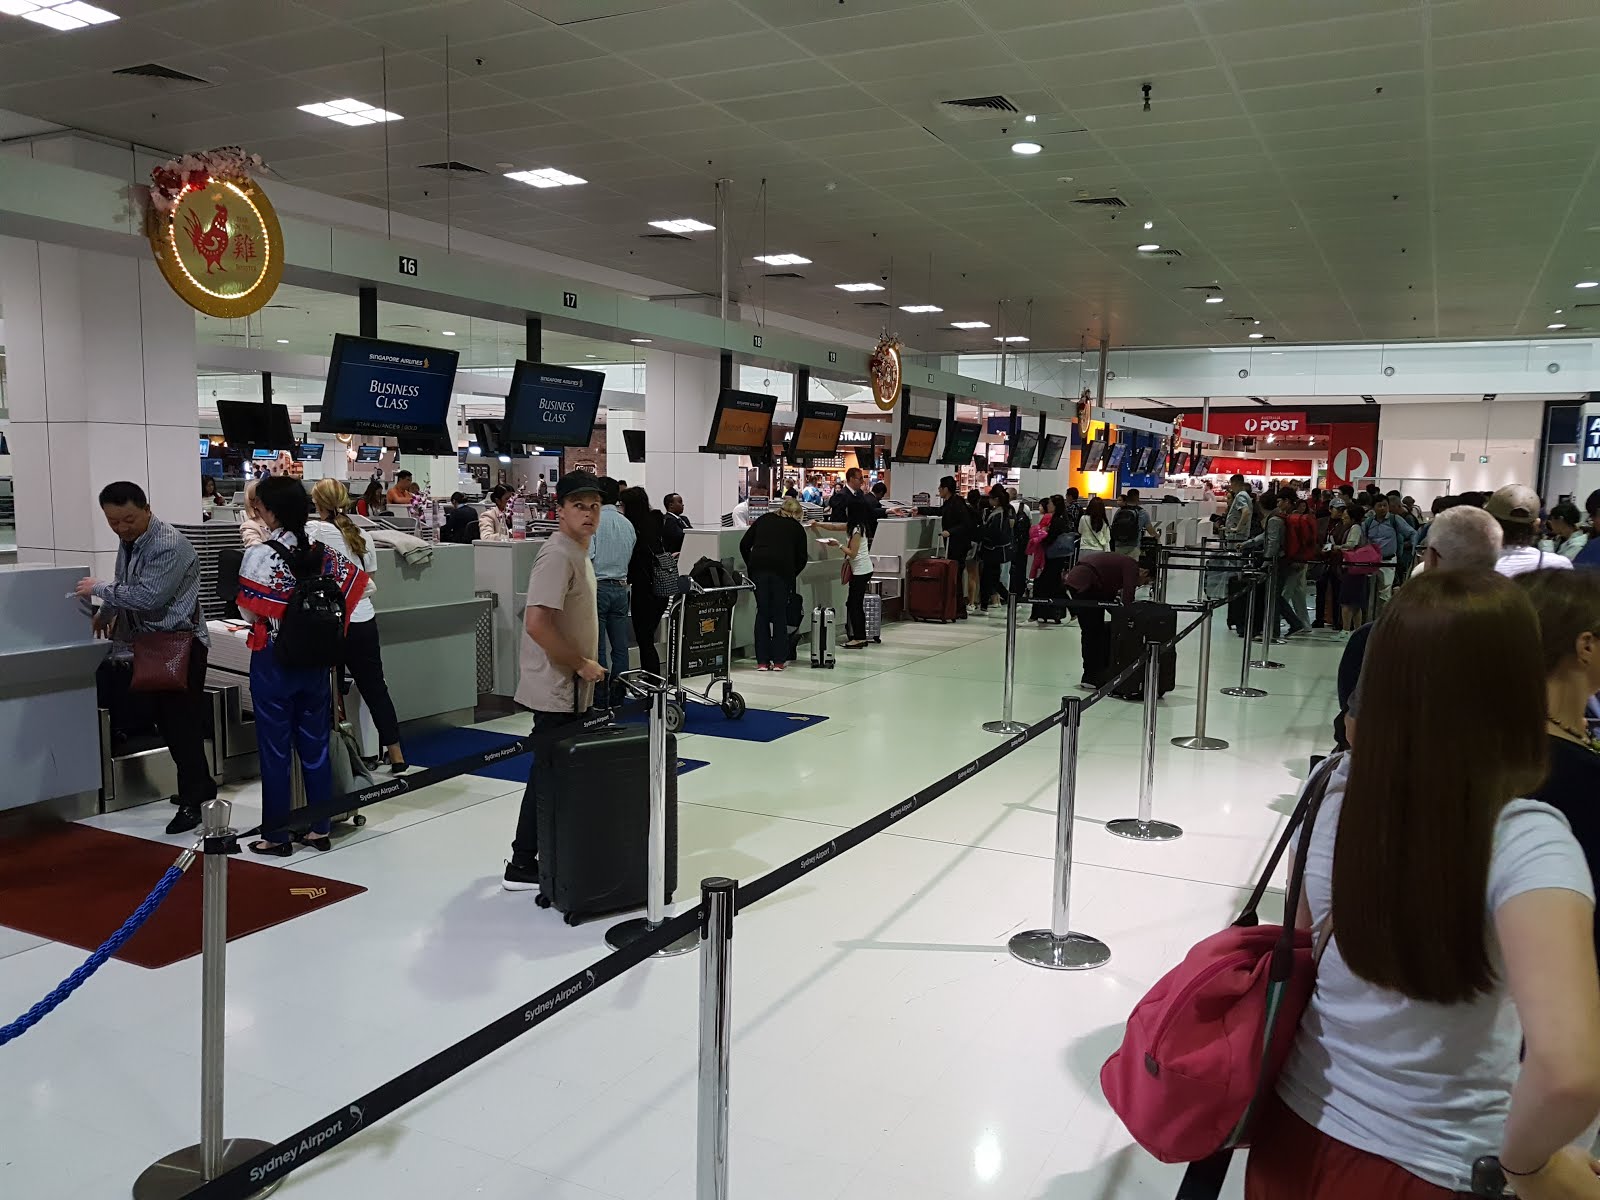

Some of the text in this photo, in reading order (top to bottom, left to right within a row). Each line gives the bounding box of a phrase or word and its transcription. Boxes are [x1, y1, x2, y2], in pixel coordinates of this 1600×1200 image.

[401, 258, 416, 274] 16
[565, 293, 576, 307] 17
[754, 336, 762, 347] 18
[368, 353, 423, 367] SINGAPORE AIRLINES
[369, 379, 420, 397] BUSINESS
[375, 395, 409, 410] CLASS
[538, 397, 576, 412] BUSINESS
[542, 410, 567, 424] CLASS
[1260, 419, 1299, 432] POST
[484, 746, 516, 761] Sydney Airport
[360, 784, 400, 802] Sydney Airport
[800, 847, 830, 869] Sydney Airport
[525, 981, 583, 1022] Sydney Airport
[250, 1120, 343, 1182] Sydney Airport
